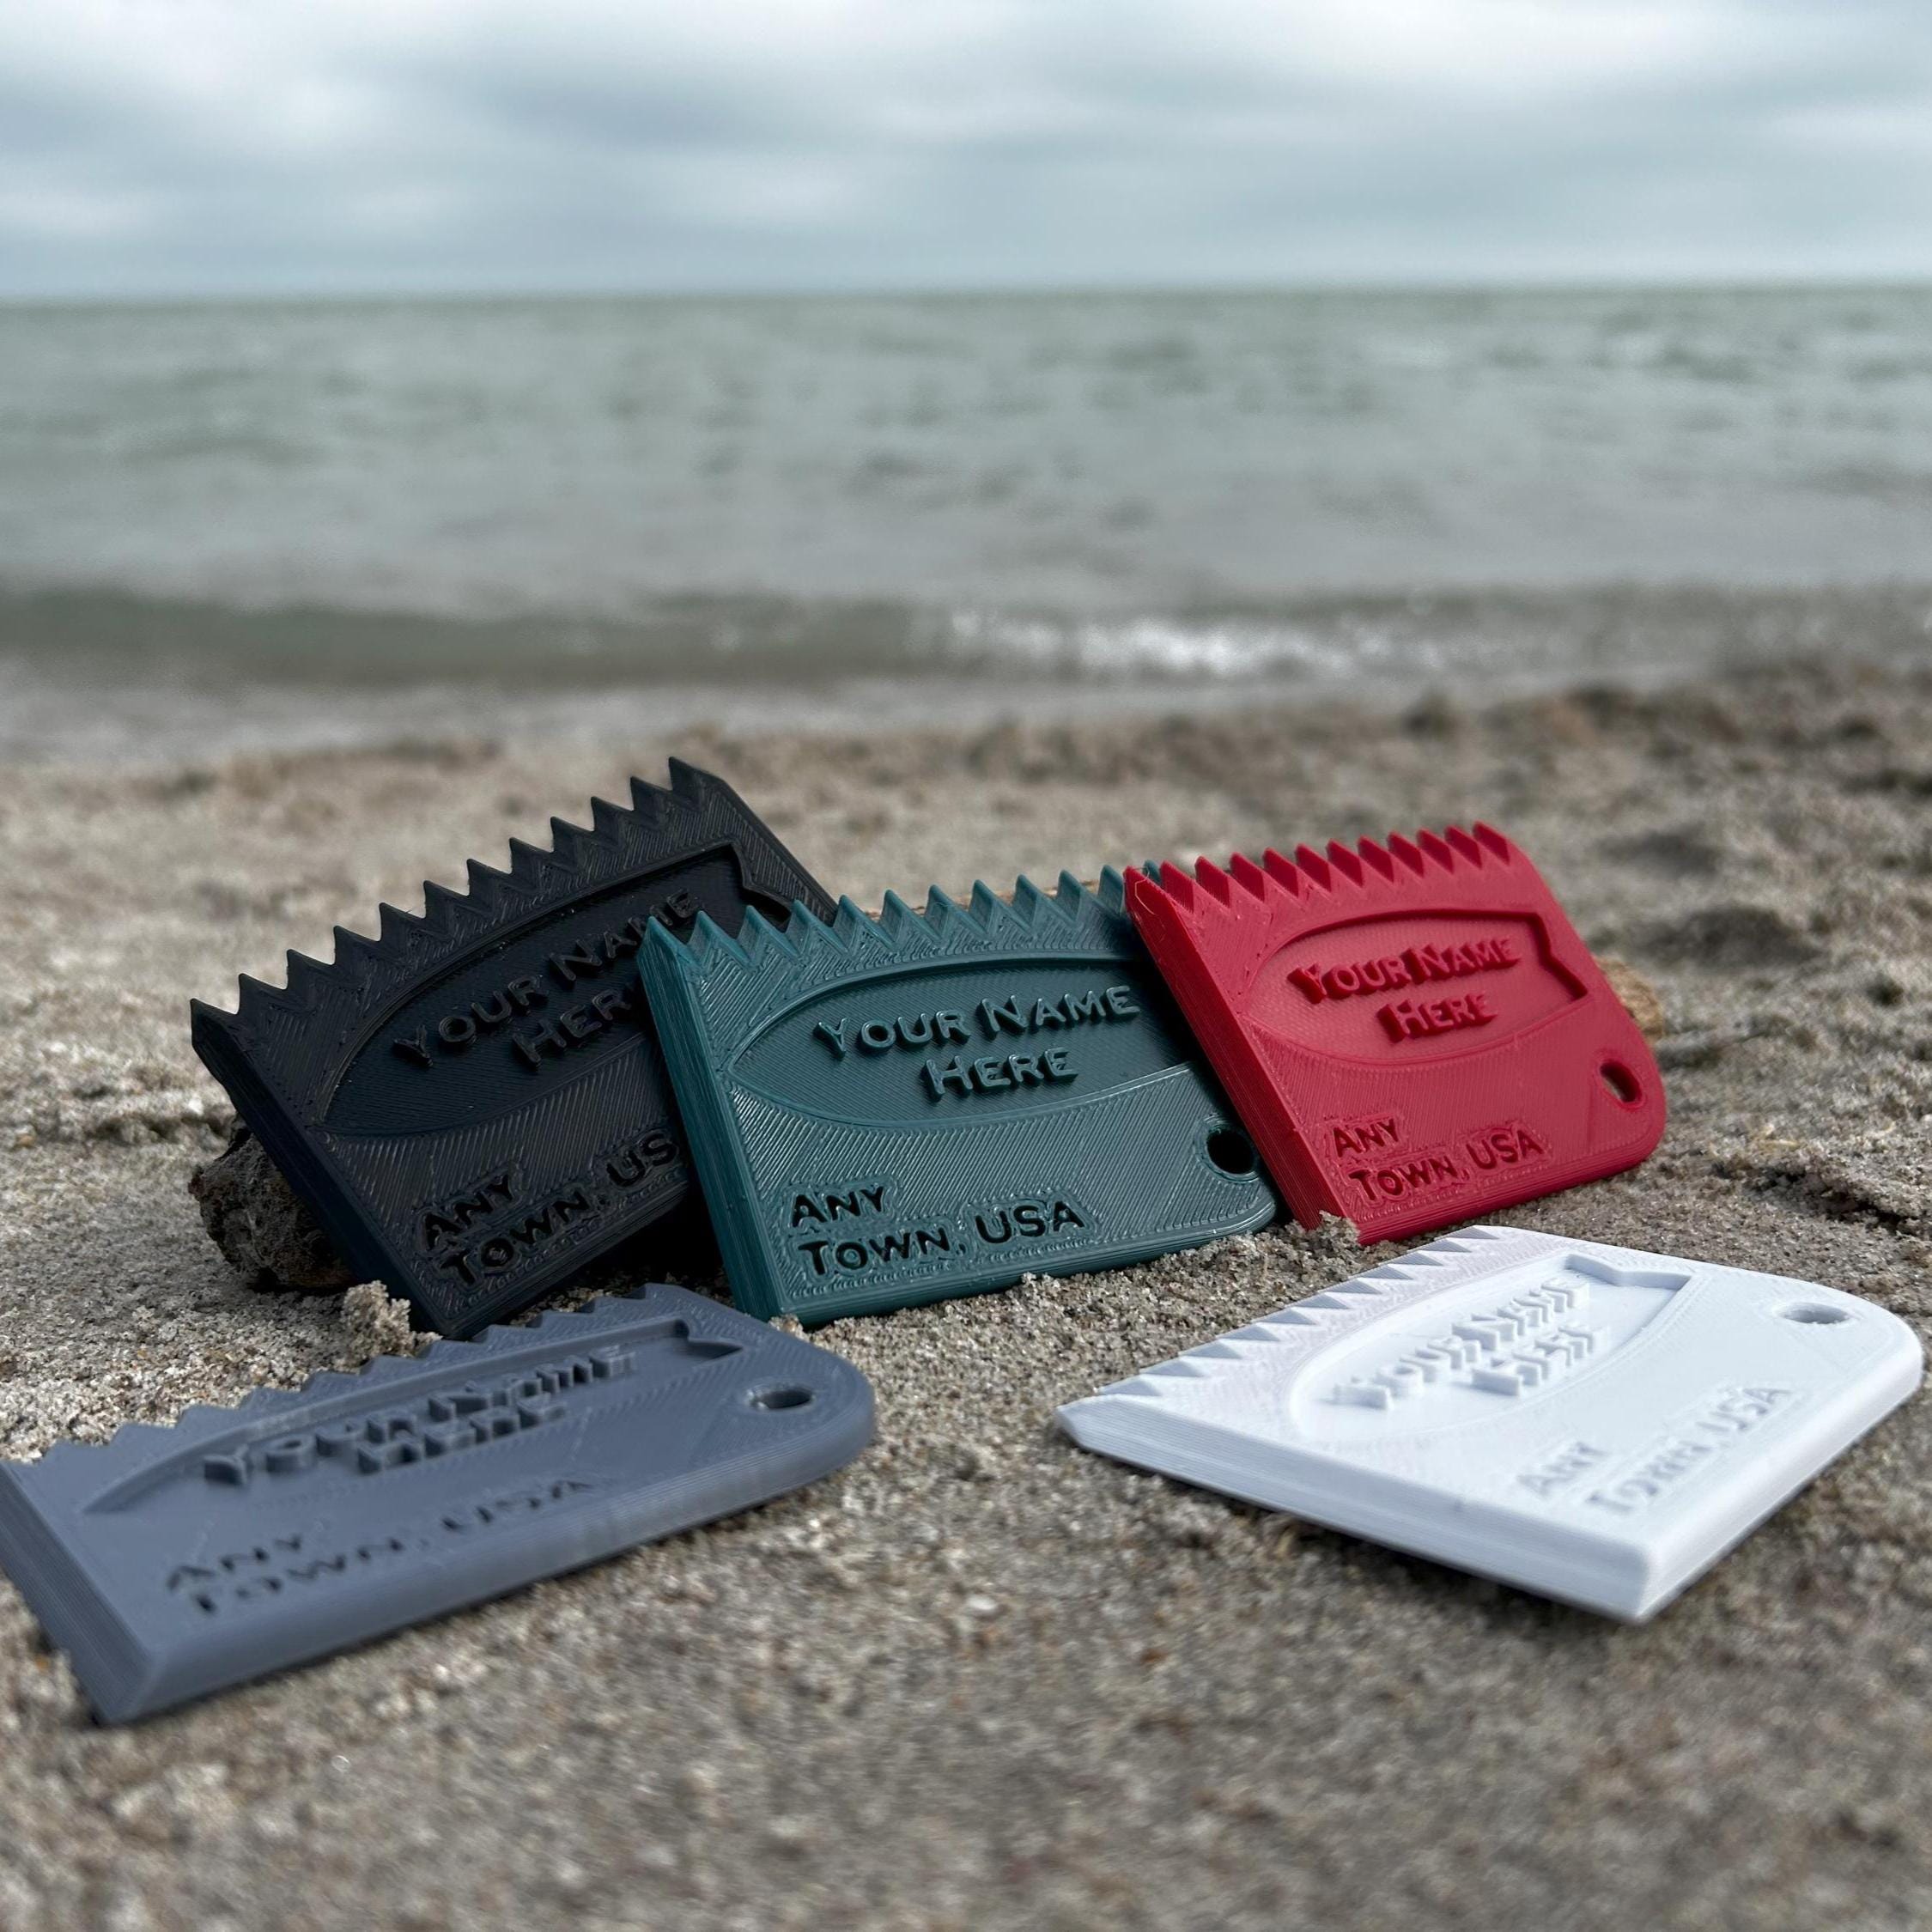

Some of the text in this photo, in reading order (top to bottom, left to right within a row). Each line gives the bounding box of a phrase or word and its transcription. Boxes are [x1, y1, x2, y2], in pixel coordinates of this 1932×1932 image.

[1287, 939, 1521, 1005] YOUR NAME
[392, 973, 546, 1066] YOUR
[510, 978, 640, 1072] HER
[813, 985, 1140, 1059] YOUR NAME
[1376, 993, 1498, 1044] HERE
[922, 1047, 1078, 1103] HERE
[606, 1133, 677, 1187] US
[1333, 1118, 1400, 1158] ANY
[1466, 1129, 1544, 1170] USA
[424, 1172, 515, 1251] ANY
[792, 1185, 885, 1228] ANY
[798, 1201, 1086, 1276] TOWN, USA
